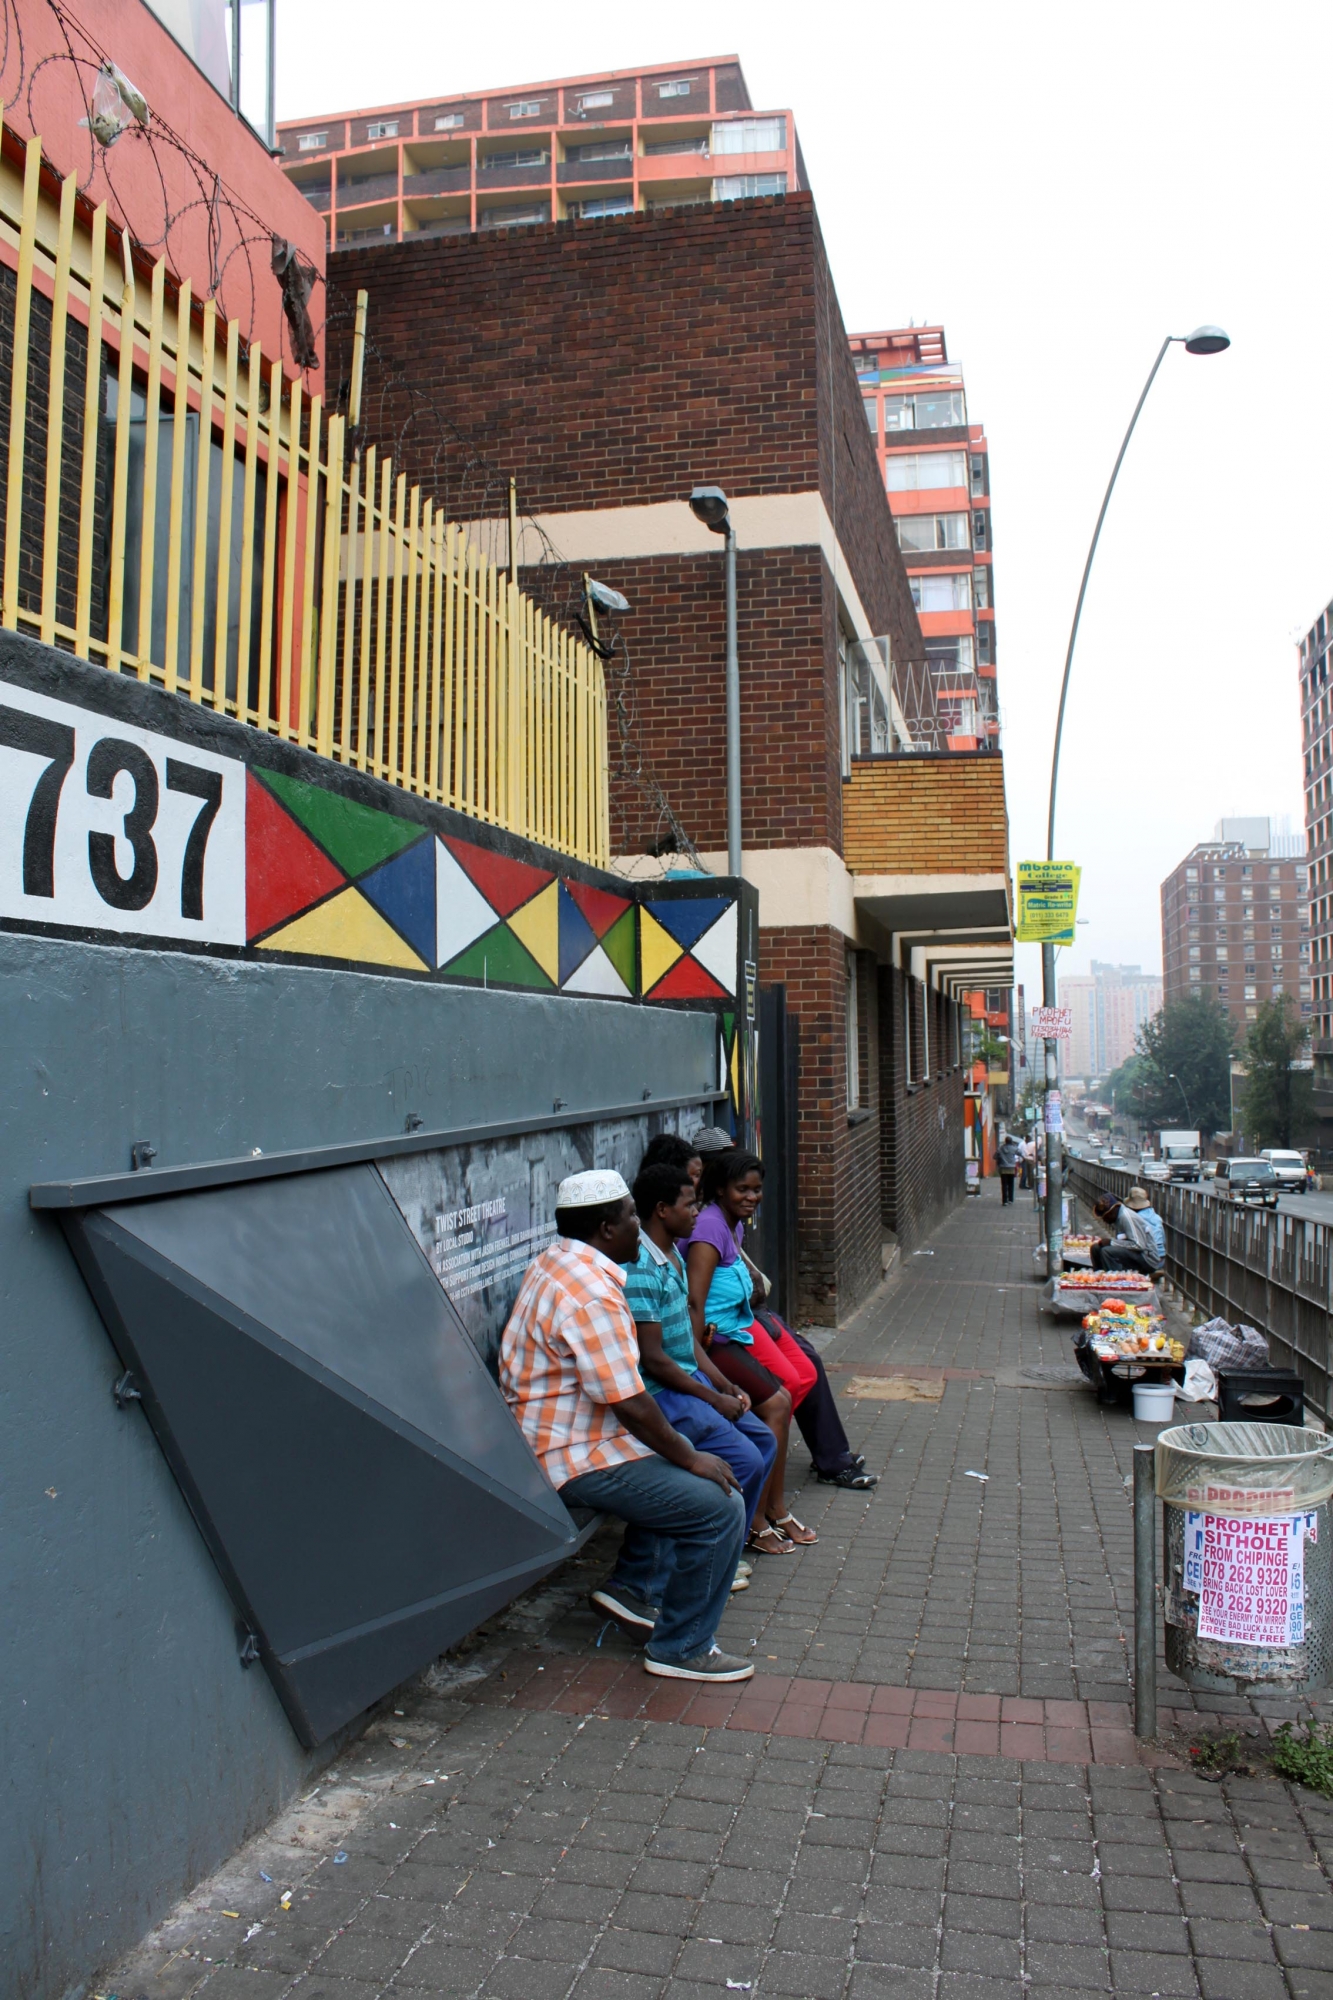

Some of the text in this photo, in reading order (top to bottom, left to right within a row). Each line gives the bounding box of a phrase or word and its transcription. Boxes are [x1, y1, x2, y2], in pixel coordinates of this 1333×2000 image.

[0, 704, 222, 920] 737
[1032, 1006, 1072, 1016] PROPHET
[1039, 1016, 1071, 1025] MPOFU
[436, 1197, 506, 1234] TWIST STREET THEATRE
[436, 1231, 474, 1254] BY LOCAL STUDIO
[442, 1251, 471, 1272] ASSOCIATION
[450, 1269, 469, 1287] SUPPORT
[469, 1265, 481, 1279] FROM
[1205, 1516, 1290, 1536] PROPHET
[1205, 1530, 1288, 1551] SITHOLE
[1204, 1544, 1288, 1567] FROM CHIPINGE
[1204, 1560, 1225, 1580] 078
[1229, 1565, 1252, 1584] 262
[1257, 1568, 1287, 1586] 9320
[1203, 1577, 1223, 1591] BRING
[1225, 1582, 1243, 1594] BACK
[1246, 1586, 1264, 1597] LOST
[1266, 1586, 1287, 1597] LOVER
[1202, 1590, 1224, 1608] 078
[1228, 1595, 1252, 1613] 262
[1257, 1598, 1287, 1615] 9320
[1201, 1615, 1226, 1627] REMOVE
[1229, 1621, 1241, 1630] BAD
[1243, 1623, 1260, 1633] LUCK
[1202, 1605, 1286, 1625] SEE YOUR ENERMY ON MIRROR
[1200, 1624, 1285, 1643] FREE FREE FREE
